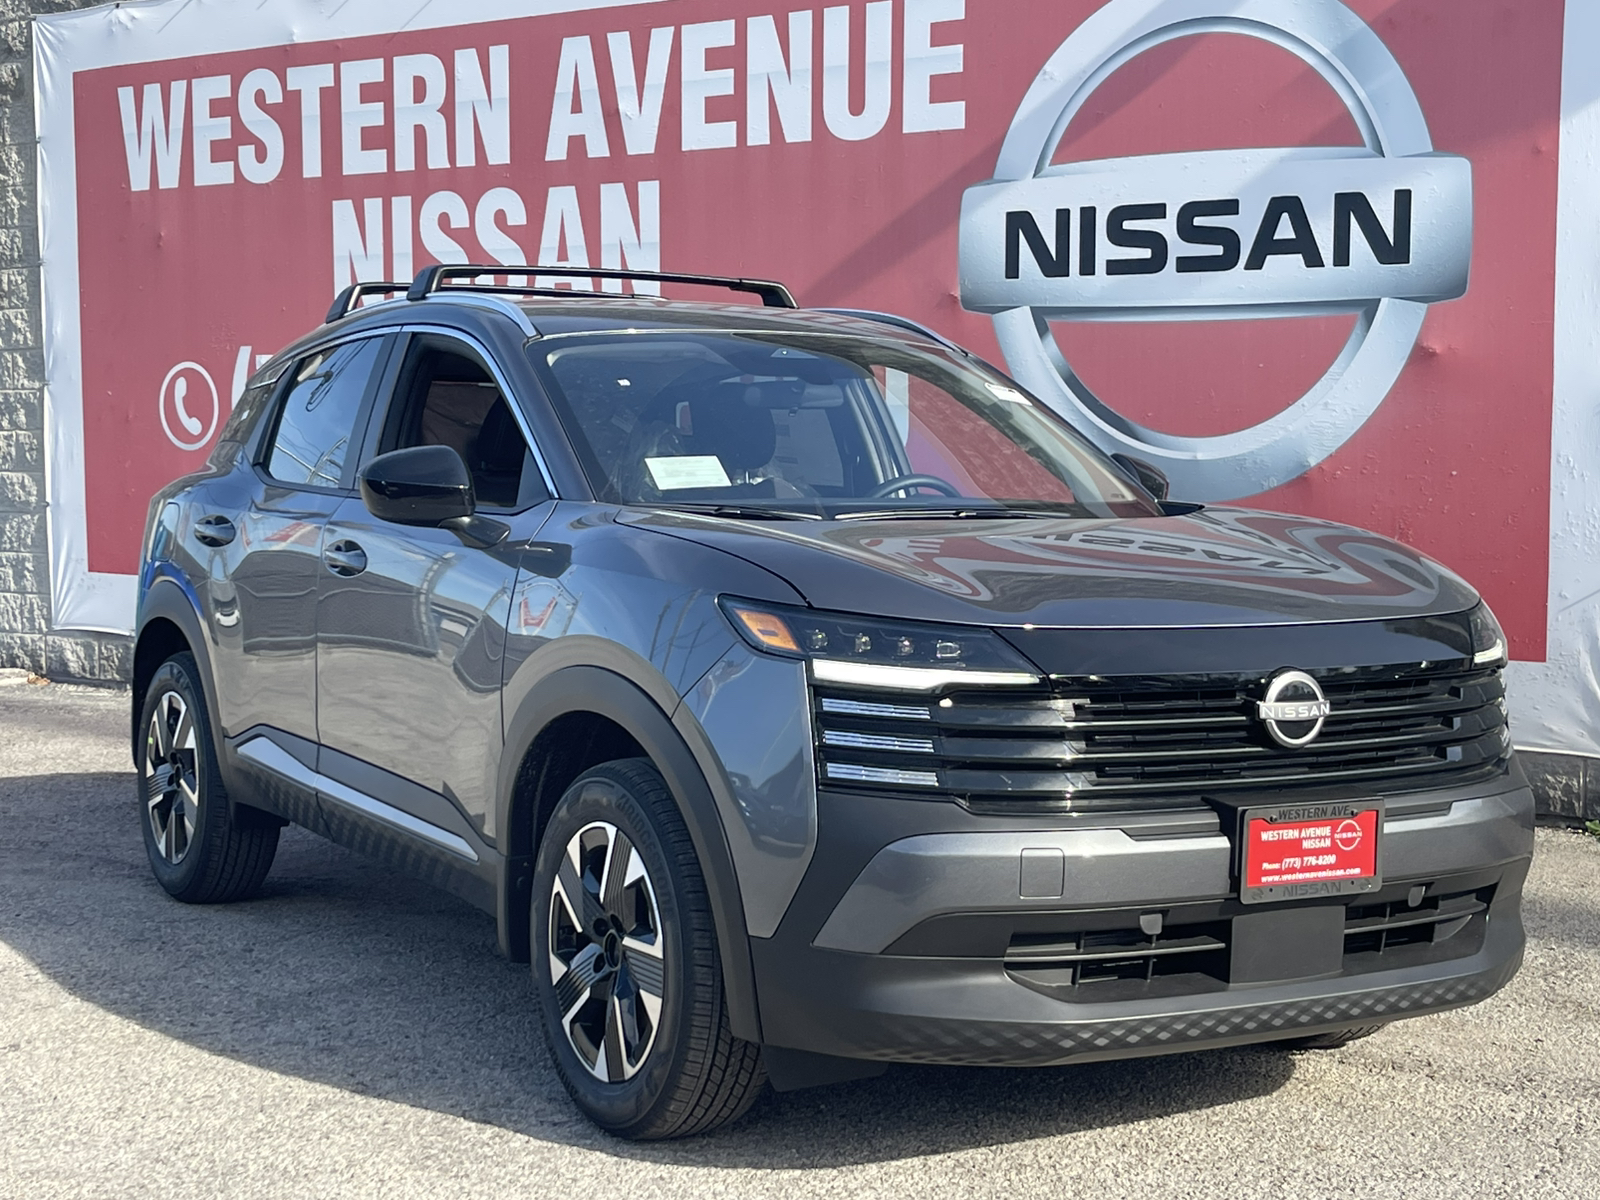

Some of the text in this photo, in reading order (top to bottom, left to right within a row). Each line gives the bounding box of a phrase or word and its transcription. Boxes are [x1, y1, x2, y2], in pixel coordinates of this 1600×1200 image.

[117, 0, 967, 192] WESTERN AVENUE
[1004, 188, 1412, 280] NISSAN
[332, 180, 662, 304] NISSAN
[1261, 702, 1329, 718] NISSAN
[1278, 805, 1350, 819] WESTERN AVE
[1261, 826, 1331, 841] WESTERN AVENUE
[1302, 838, 1331, 849] NISSAN
[1262, 854, 1336, 871] Phone: (773) 776-8200
[1261, 868, 1360, 882] www.westernavenissan.com
[1283, 883, 1341, 897] NISSAN
